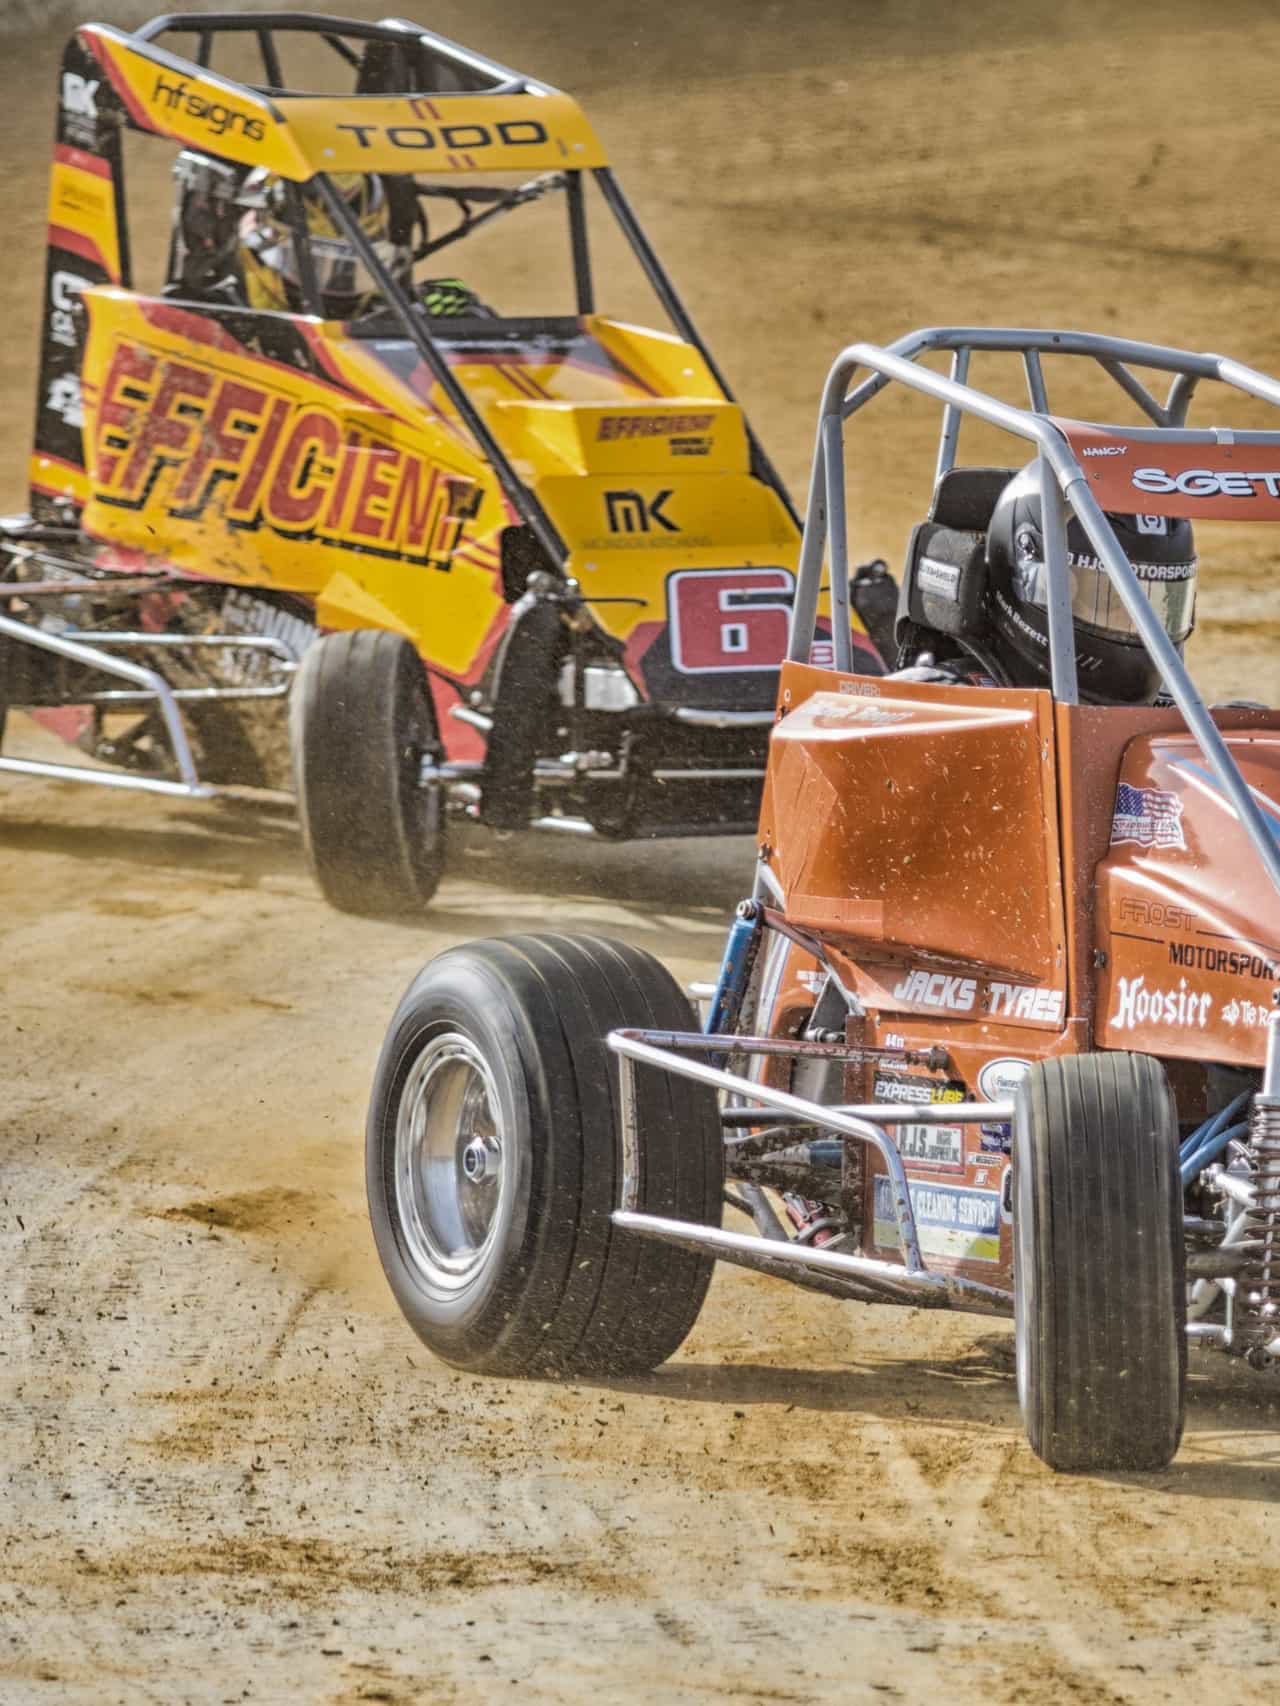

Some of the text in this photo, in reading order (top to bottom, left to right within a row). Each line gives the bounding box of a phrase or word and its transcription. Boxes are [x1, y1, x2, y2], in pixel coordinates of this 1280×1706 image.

[336, 120, 549, 149] TODD
[596, 414, 717, 443] EFFICIENT
[1082, 445, 1128, 457] NANCY
[603, 488, 682, 533] MK
[1129, 562, 1197, 580] OTORSPORT
[667, 567, 795, 675] 6
[1119, 897, 1199, 932] FROST
[894, 969, 1066, 1023] JACKS TYRES
[1109, 974, 1214, 1031] Hoosier
